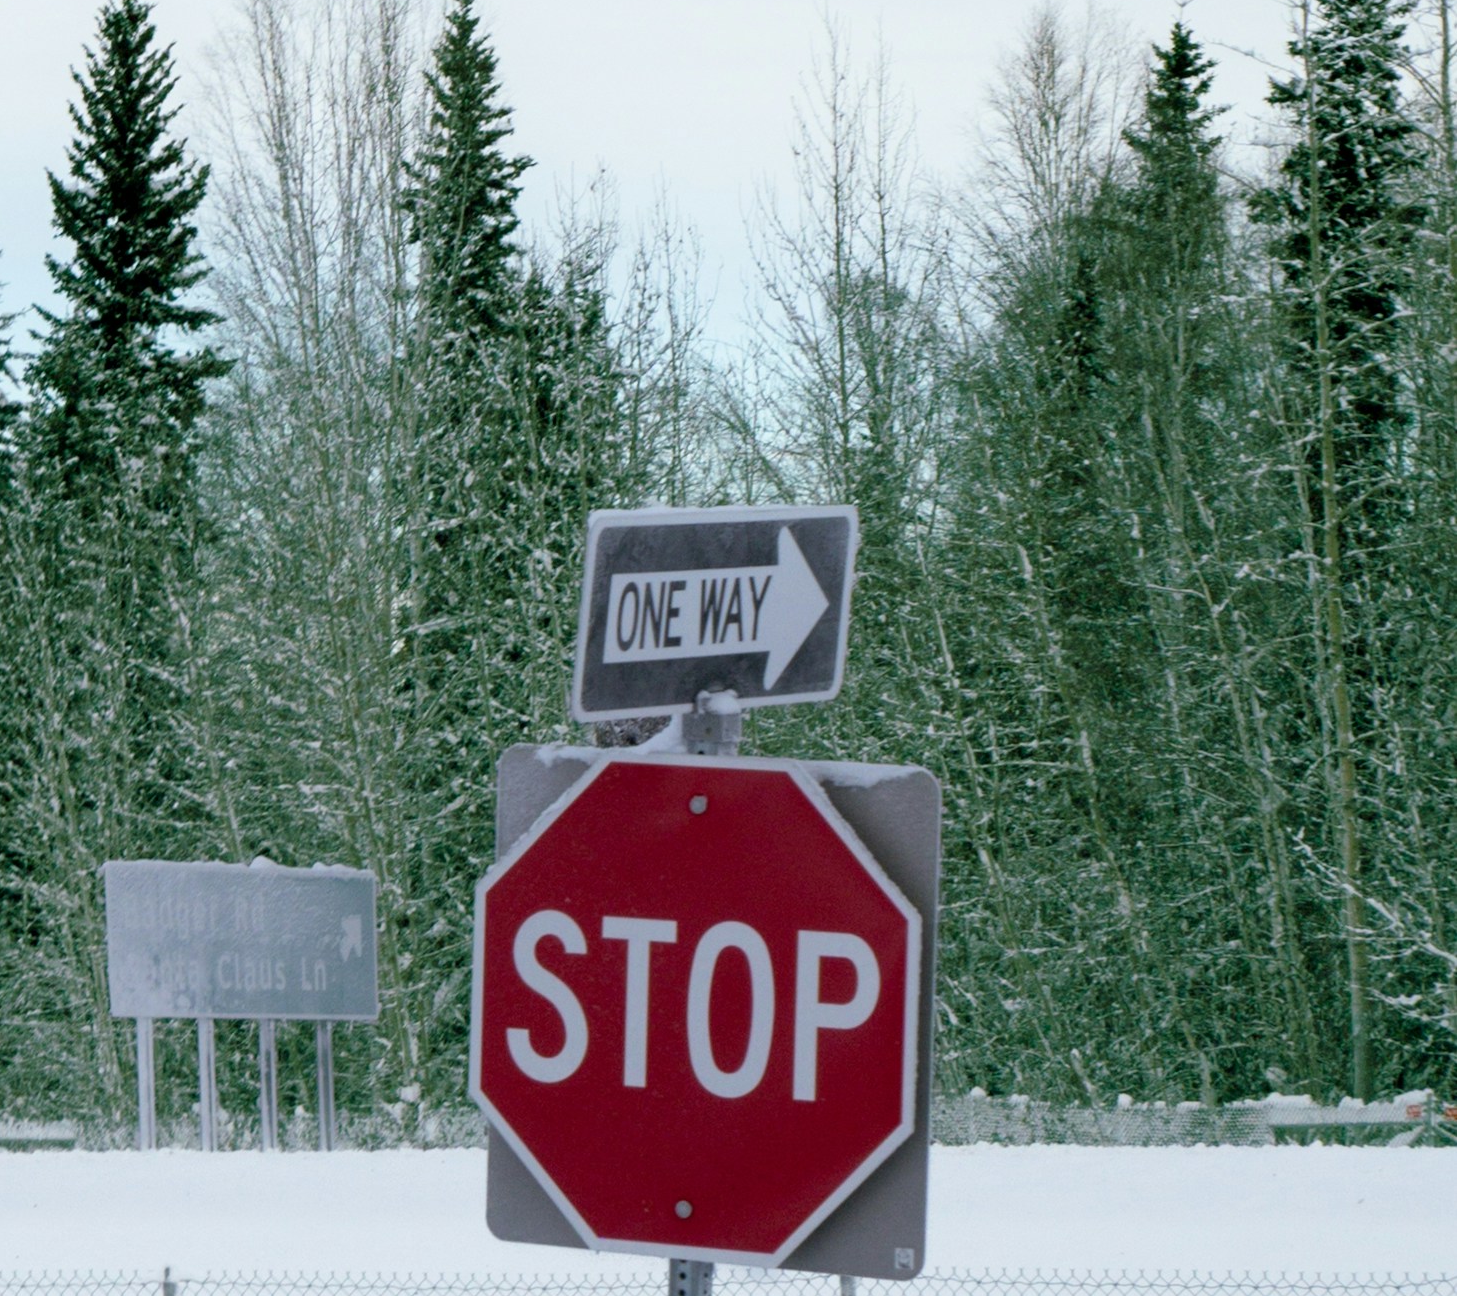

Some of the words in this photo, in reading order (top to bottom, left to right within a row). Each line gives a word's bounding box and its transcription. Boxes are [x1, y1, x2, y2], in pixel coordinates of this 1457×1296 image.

[616, 579, 687, 652] ONE
[698, 574, 774, 646] WAY
[216, 951, 287, 992] Claus
[300, 956, 328, 992] Ln
[505, 908, 882, 1103] STOP
